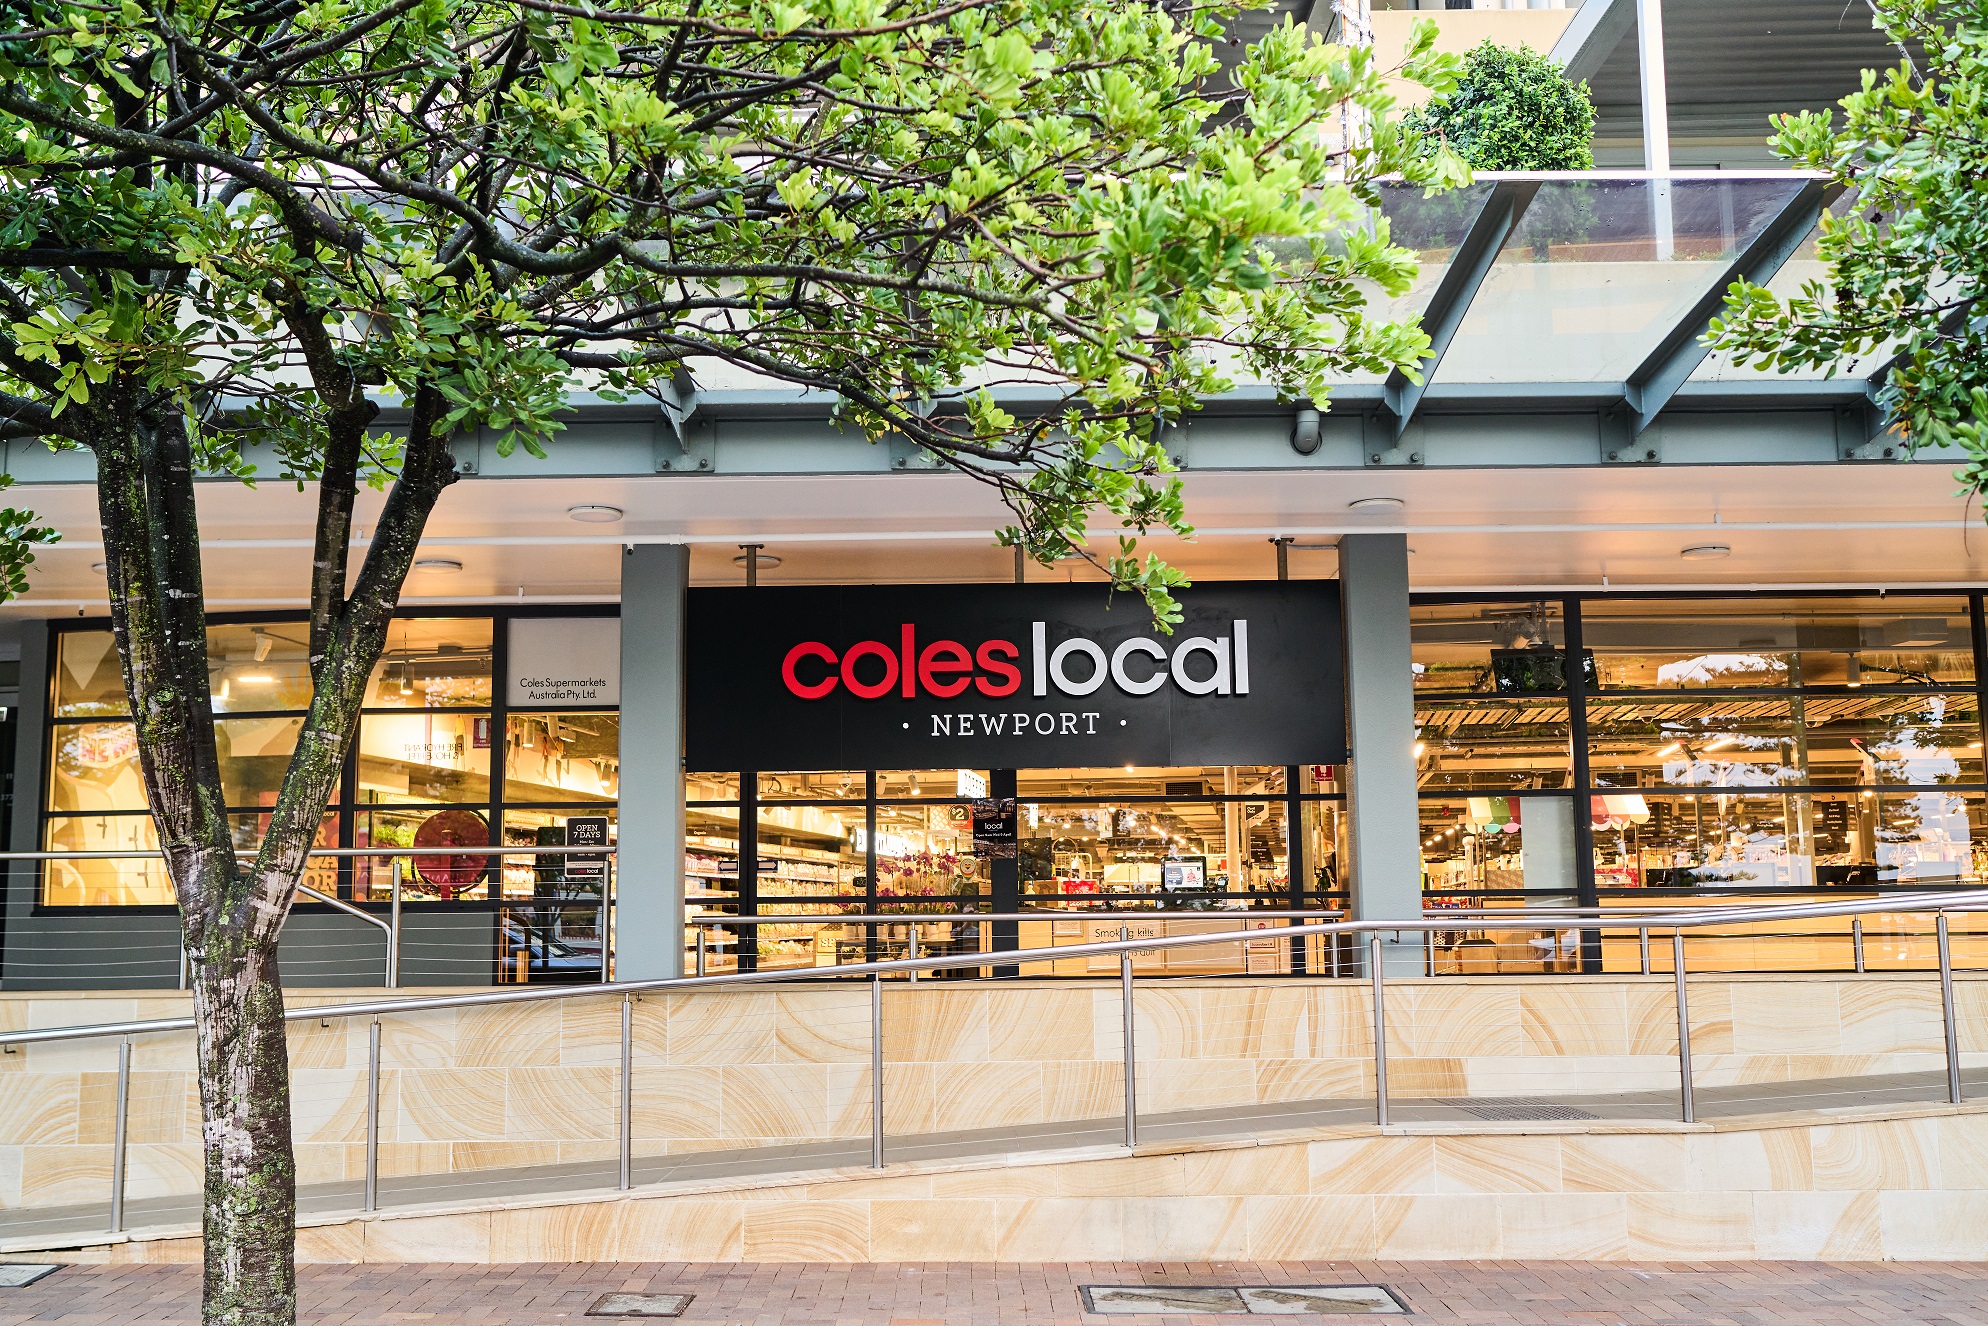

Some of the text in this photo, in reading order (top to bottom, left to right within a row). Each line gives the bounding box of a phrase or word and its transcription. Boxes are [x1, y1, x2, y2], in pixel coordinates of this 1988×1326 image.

[781, 619, 1250, 699] coles local
[520, 677, 607, 689] Coles Supermarkets
[528, 688, 597, 701] Australia Pty. Ltd.
[930, 712, 1100, 737] NEWPORT
[576, 824, 599, 832] OPEN
[984, 821, 1003, 830] local
[573, 831, 601, 839] 7 DAYS
[1094, 928, 1154, 939] Smokg kills
